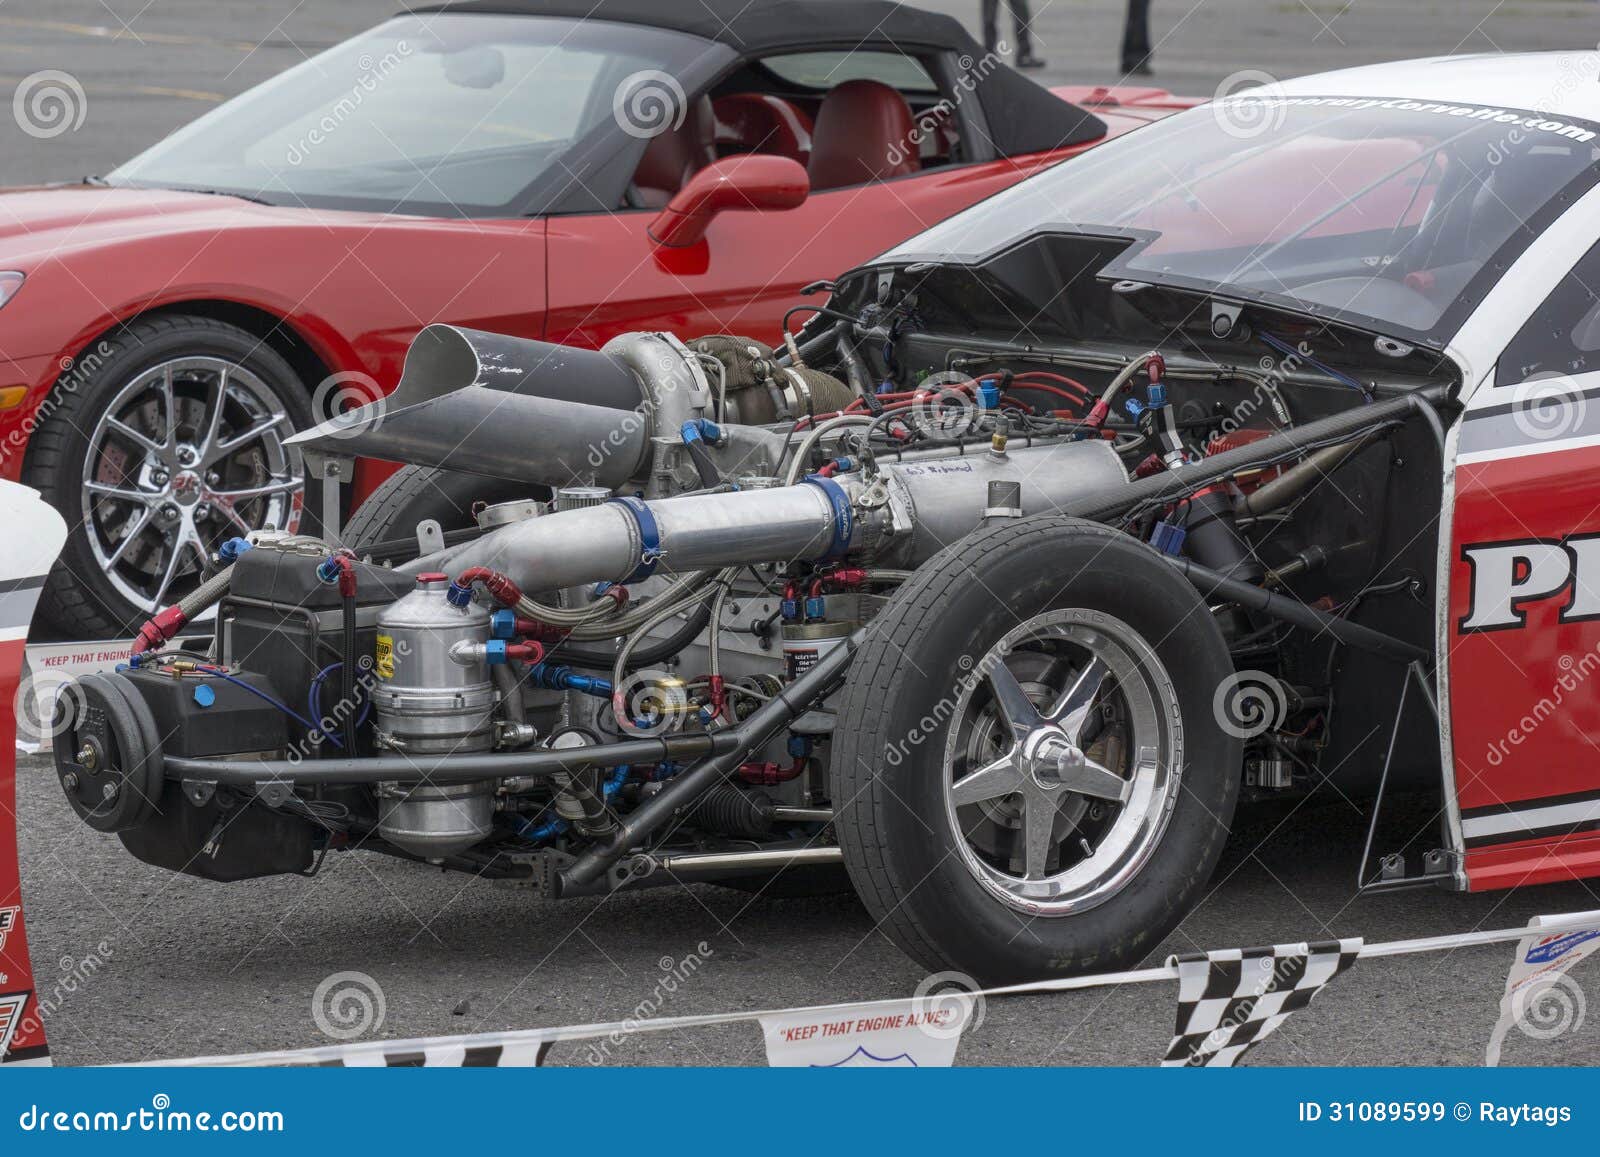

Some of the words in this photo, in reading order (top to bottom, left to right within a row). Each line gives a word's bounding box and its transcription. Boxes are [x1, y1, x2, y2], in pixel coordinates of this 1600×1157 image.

[72, 653, 95, 665] THAT
[97, 650, 133, 661] ENGINE
[822, 1020, 853, 1037] THAT
[856, 1015, 901, 1032] ENGINE
